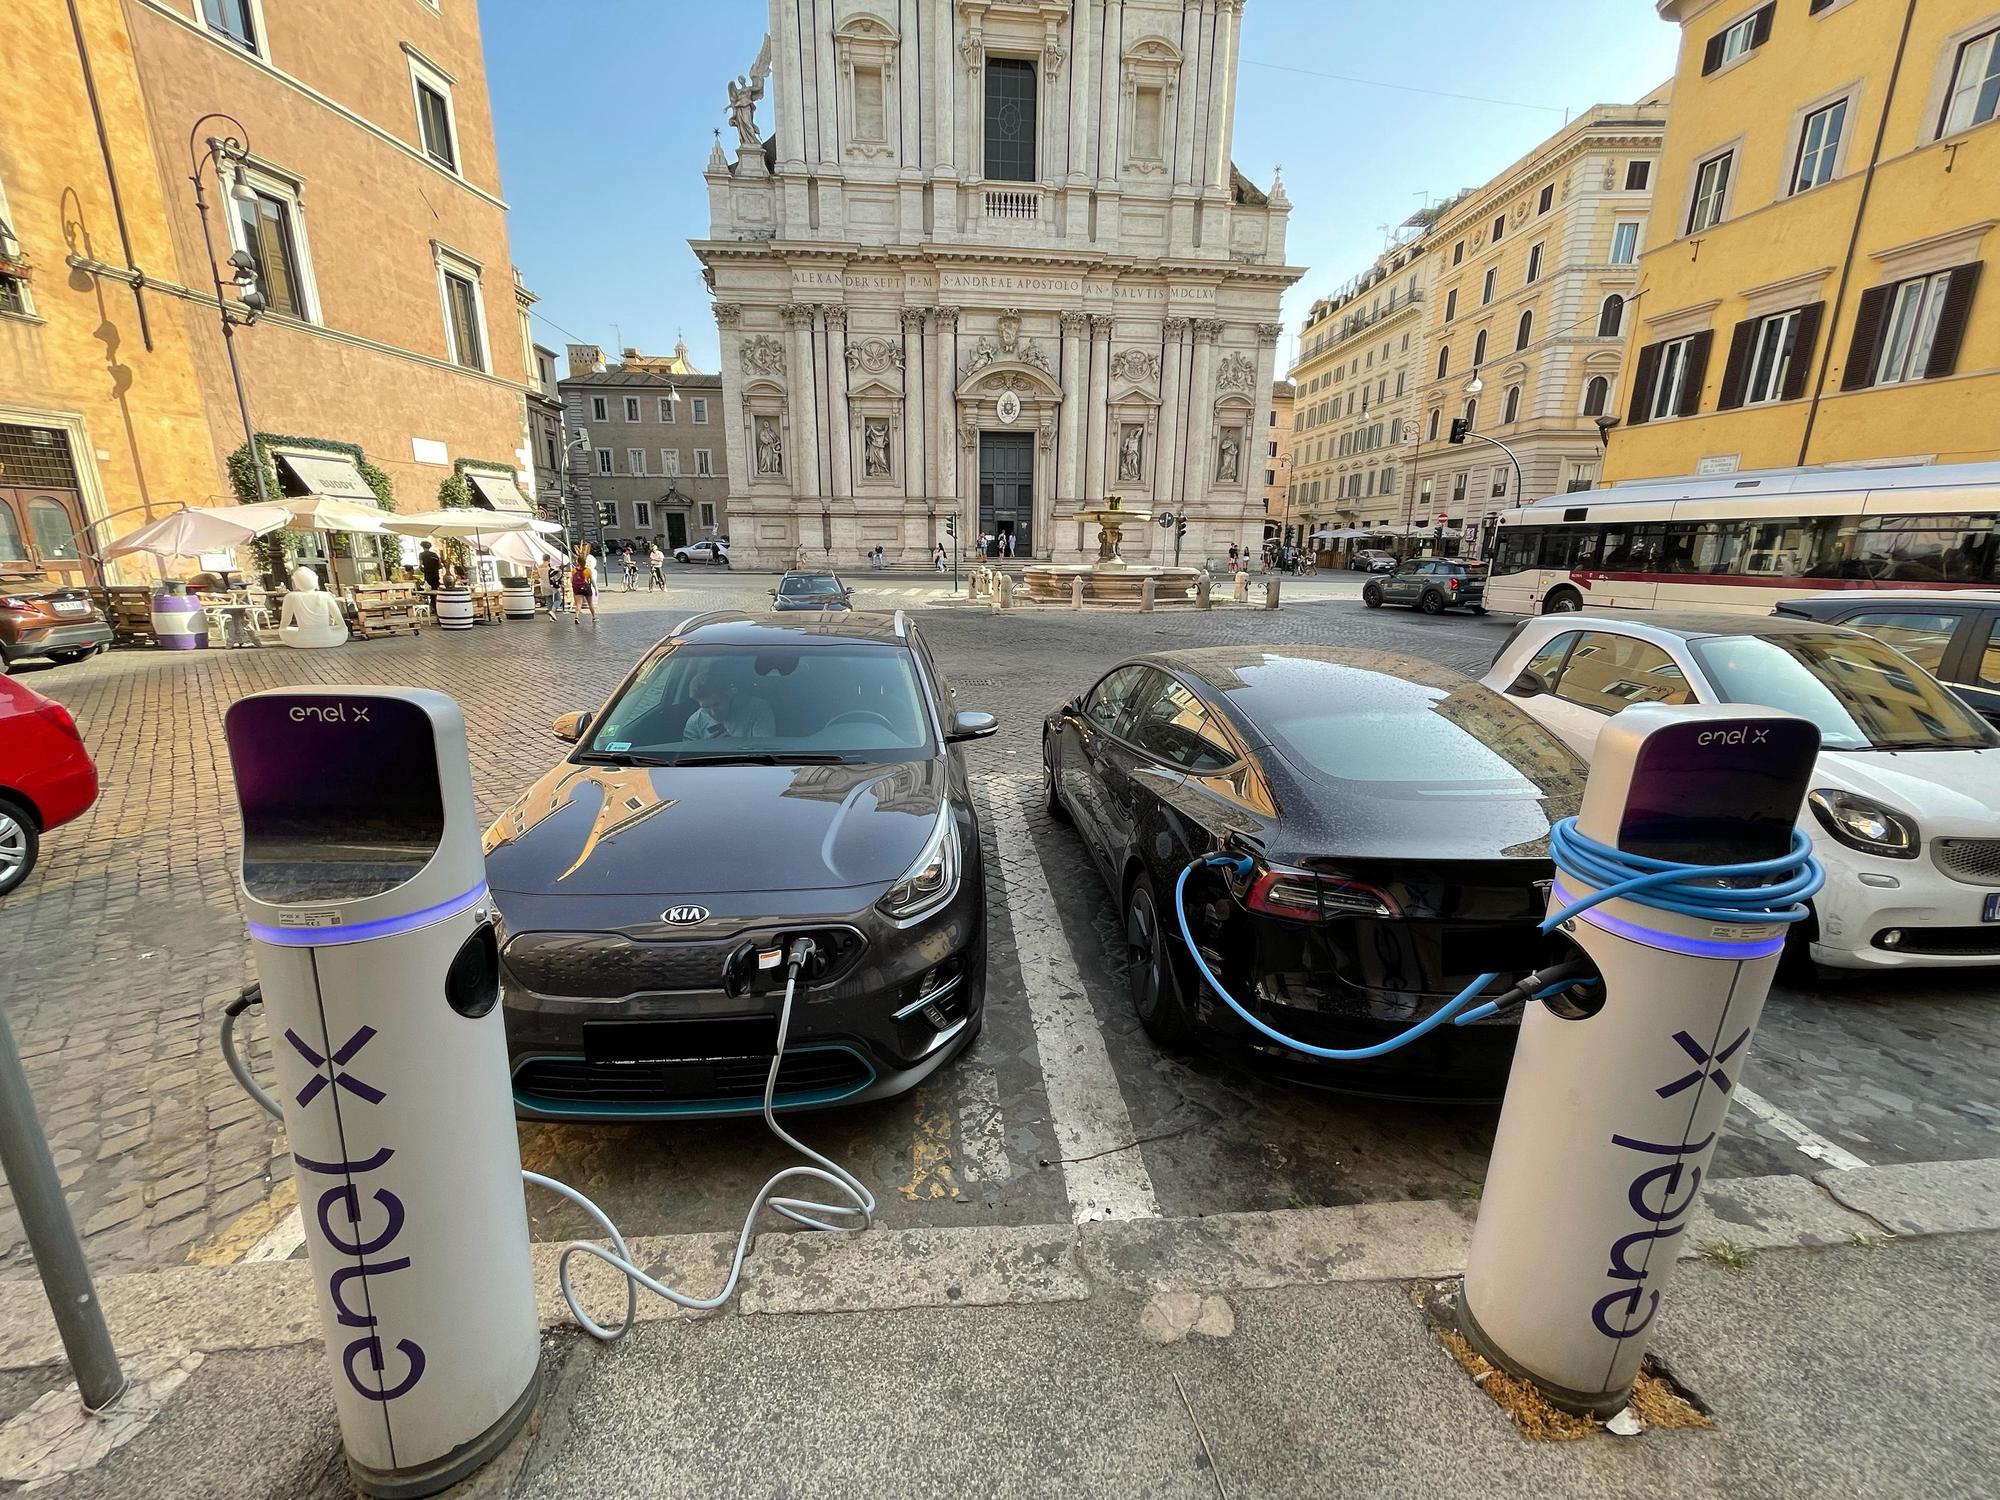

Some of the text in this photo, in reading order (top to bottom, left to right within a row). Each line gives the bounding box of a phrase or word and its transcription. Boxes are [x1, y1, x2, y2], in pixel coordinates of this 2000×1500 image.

[1017, 279, 1080, 291] APOSTOLO
[1114, 286, 1165, 299] SALVTIS
[1170, 287, 1216, 299] MDCLXV
[319, 479, 356, 490] BUDDY
[289, 702, 347, 722] enel
[1697, 726, 1748, 746] enel
[669, 907, 701, 921] KIA
[1591, 1131, 1716, 1340] enel
[294, 1147, 427, 1402] enel
